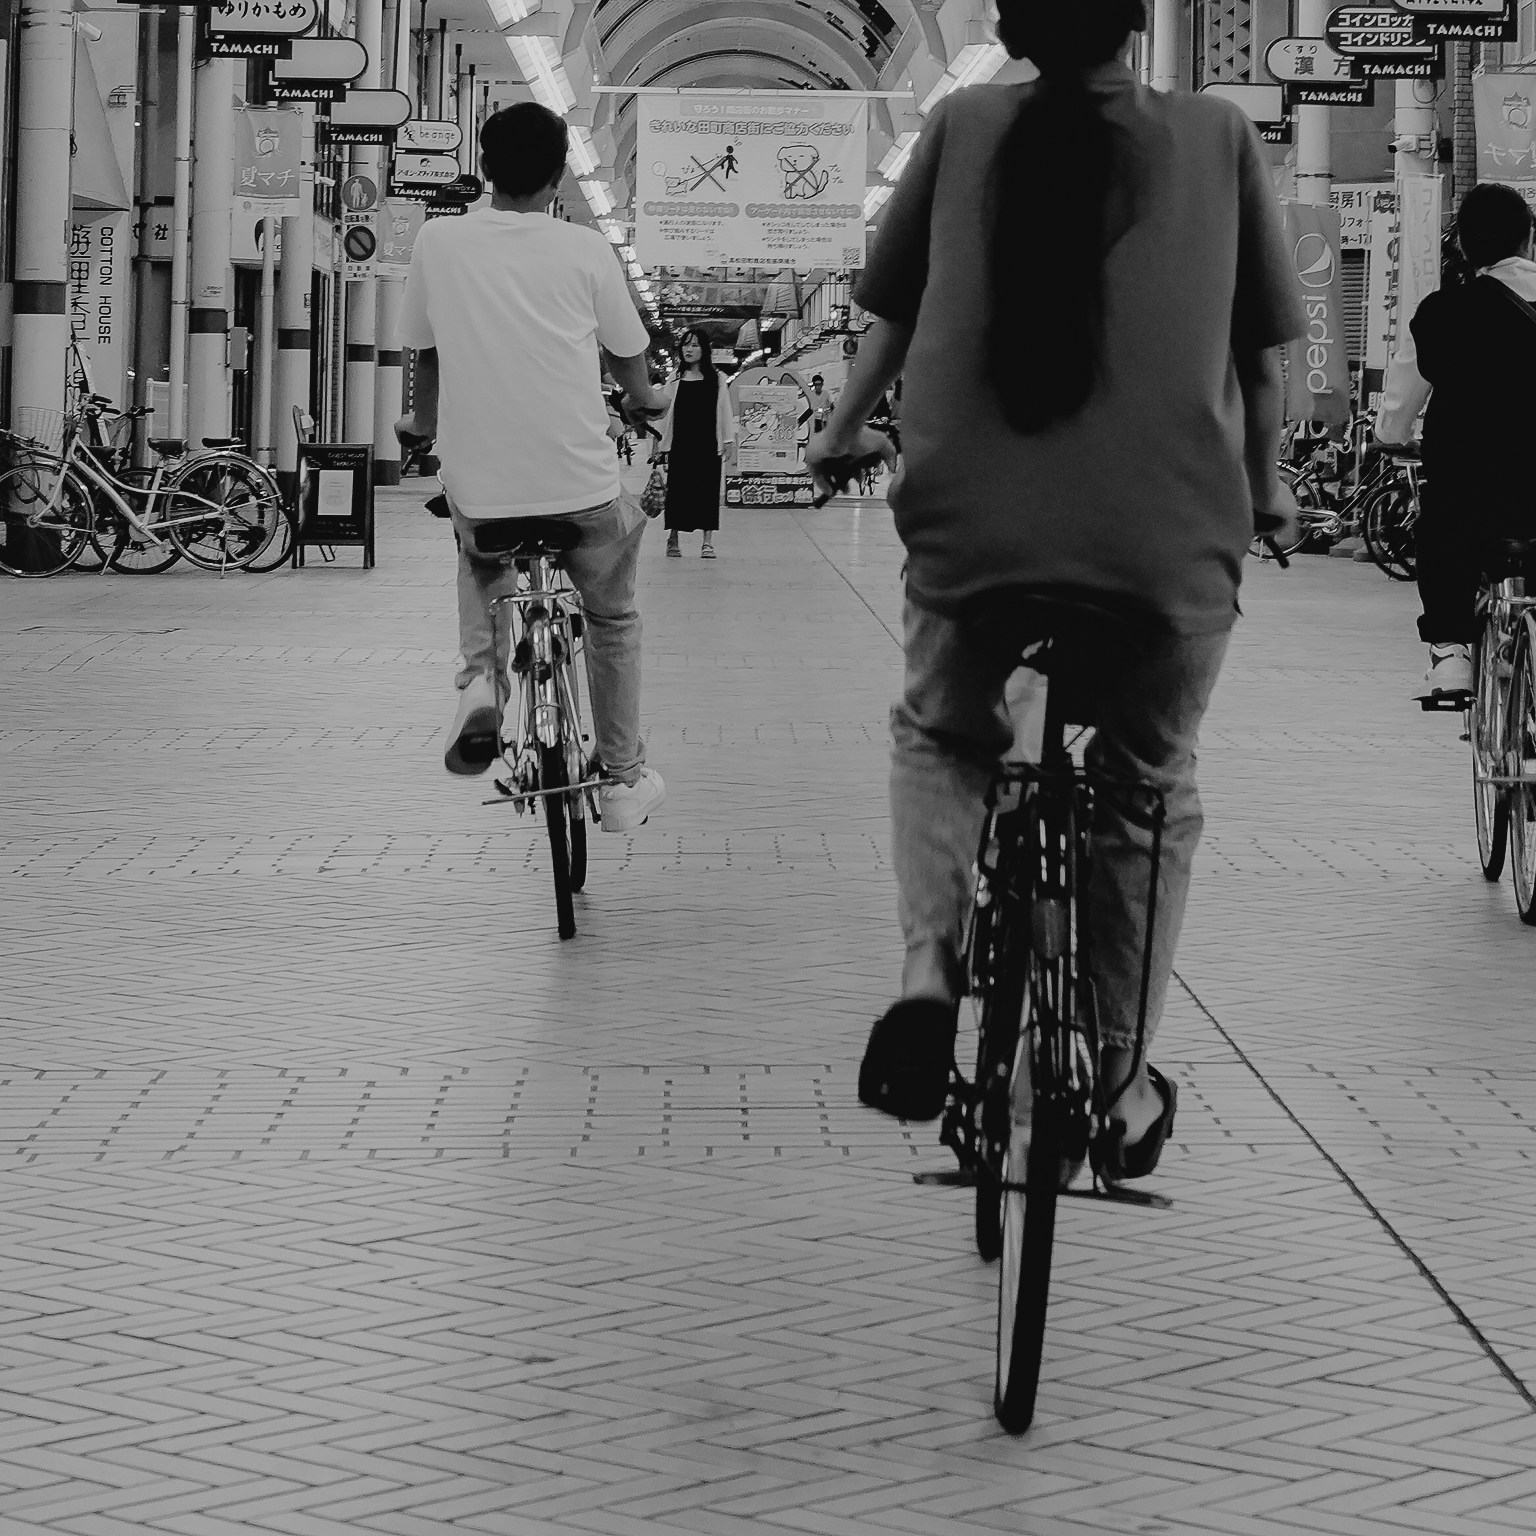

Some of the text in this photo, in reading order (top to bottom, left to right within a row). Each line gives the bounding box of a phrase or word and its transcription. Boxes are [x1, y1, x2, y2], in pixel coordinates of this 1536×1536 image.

[217, 1, 308, 20] ゆりかもめ
[1426, 23, 1503, 38] TAMACHI
[1339, 32, 1426, 47] コインドリン
[210, 42, 280, 56] TAMACHI
[1282, 44, 1318, 54] くすり
[1363, 64, 1431, 75] TAMACHI
[273, 87, 335, 100] TAMACHI
[1299, 91, 1363, 102] TAMACHI
[330, 131, 383, 143] TAMACHI
[239, 166, 295, 188] 夏マチ
[392, 187, 437, 197] TAMACHI
[426, 206, 461, 214] AMACHI
[97, 225, 114, 345] COTTON HOUSE
[1301, 293, 1334, 395] pepsi
